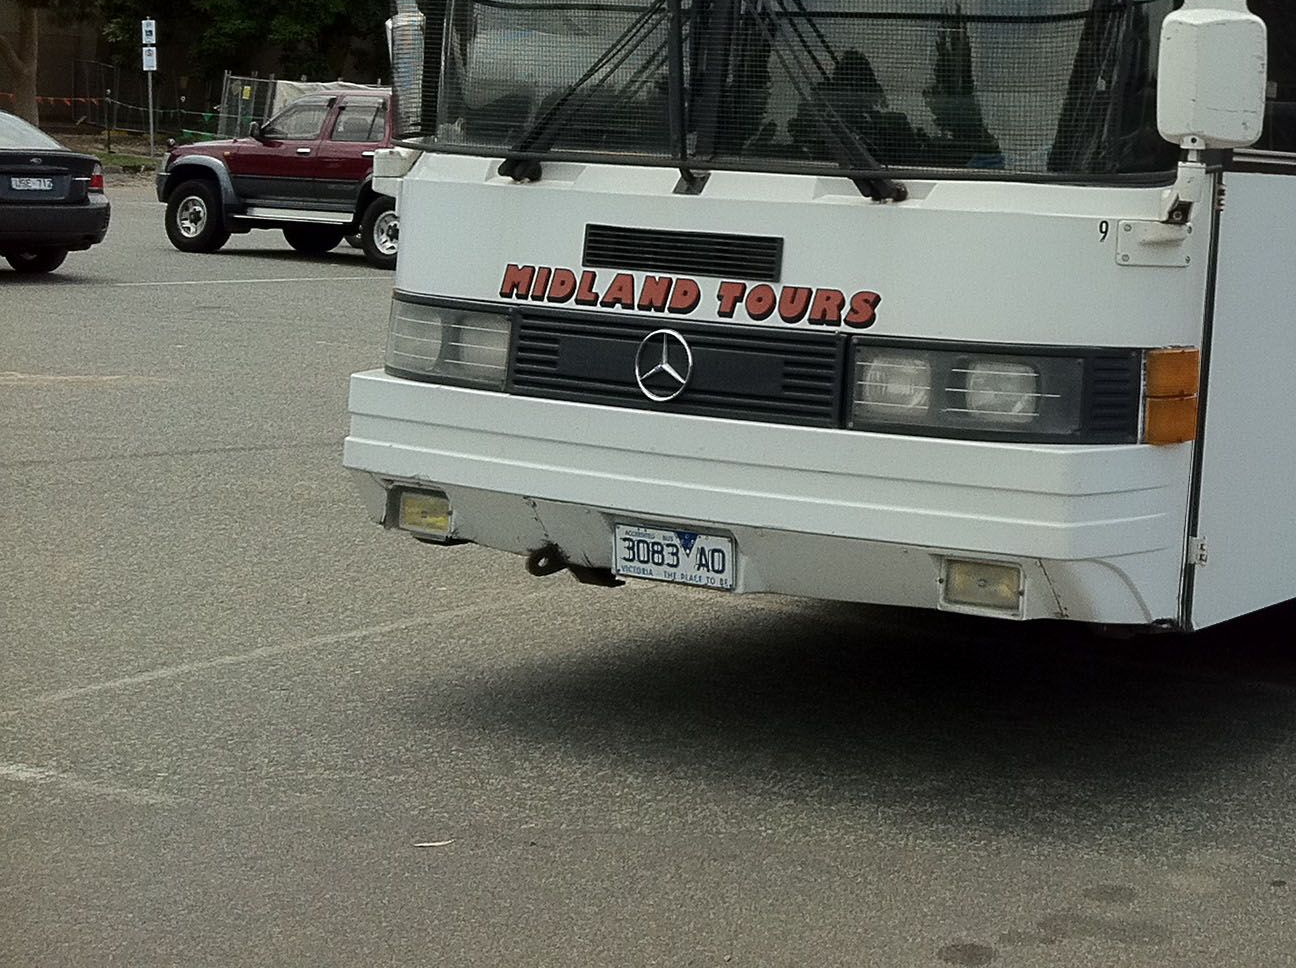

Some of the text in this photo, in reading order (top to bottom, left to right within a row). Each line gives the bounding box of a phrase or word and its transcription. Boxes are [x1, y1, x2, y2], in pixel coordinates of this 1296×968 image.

[1099, 220, 1109, 243] 9
[499, 263, 882, 329] MIDLAND TOURS
[620, 537, 680, 568] 3083
[622, 565, 654, 577] VICTORIA
[663, 571, 678, 580] THE
[706, 576, 716, 585] TO
